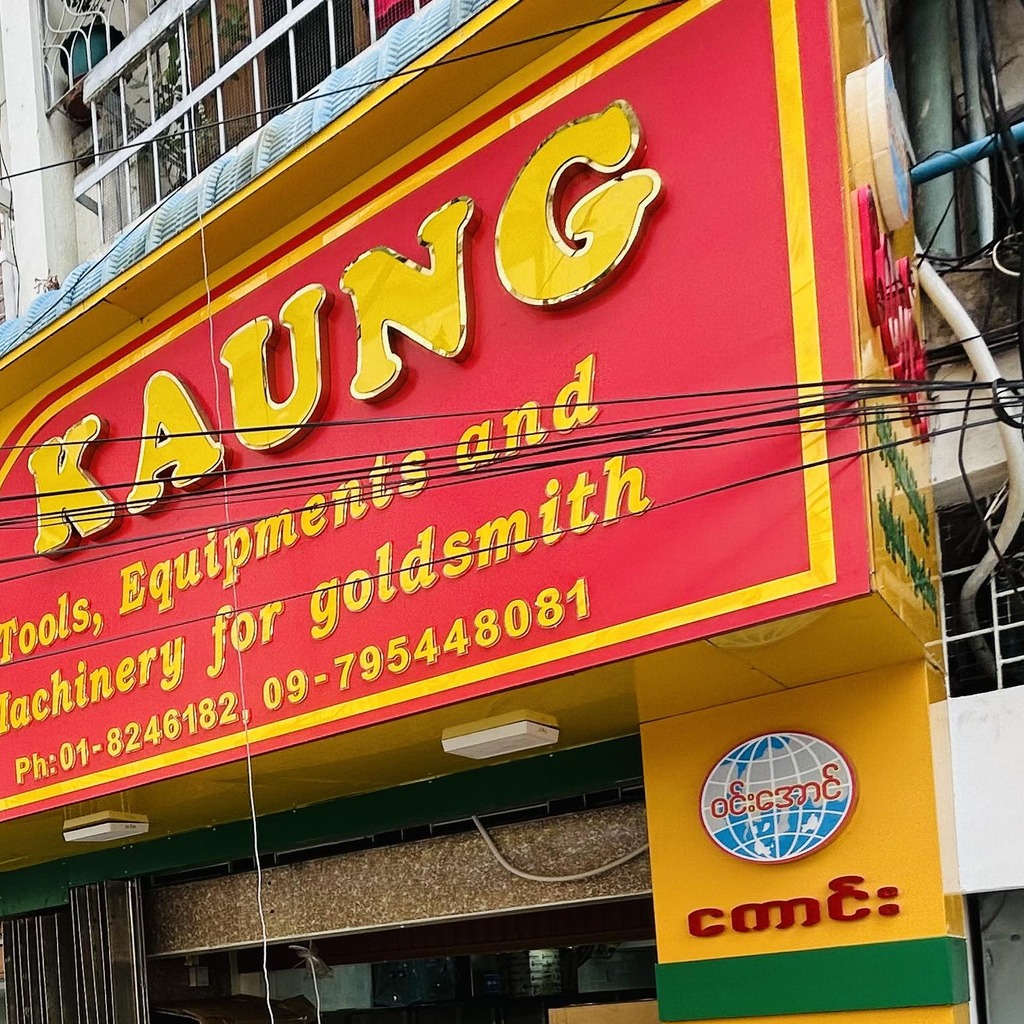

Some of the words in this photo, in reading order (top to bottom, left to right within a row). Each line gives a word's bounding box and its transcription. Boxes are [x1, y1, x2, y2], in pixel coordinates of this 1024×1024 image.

[28, 99, 662, 558] KAUNG
[121, 445, 430, 612] Equipments
[456, 354, 599, 473] and
[207, 602, 284, 676] for
[311, 455, 654, 641] goldsmith
[263, 578, 591, 709] 09-795448081
[711, 763, 842, 819] ဝင်းအောင်
[688, 875, 900, 938] ကောင်း
